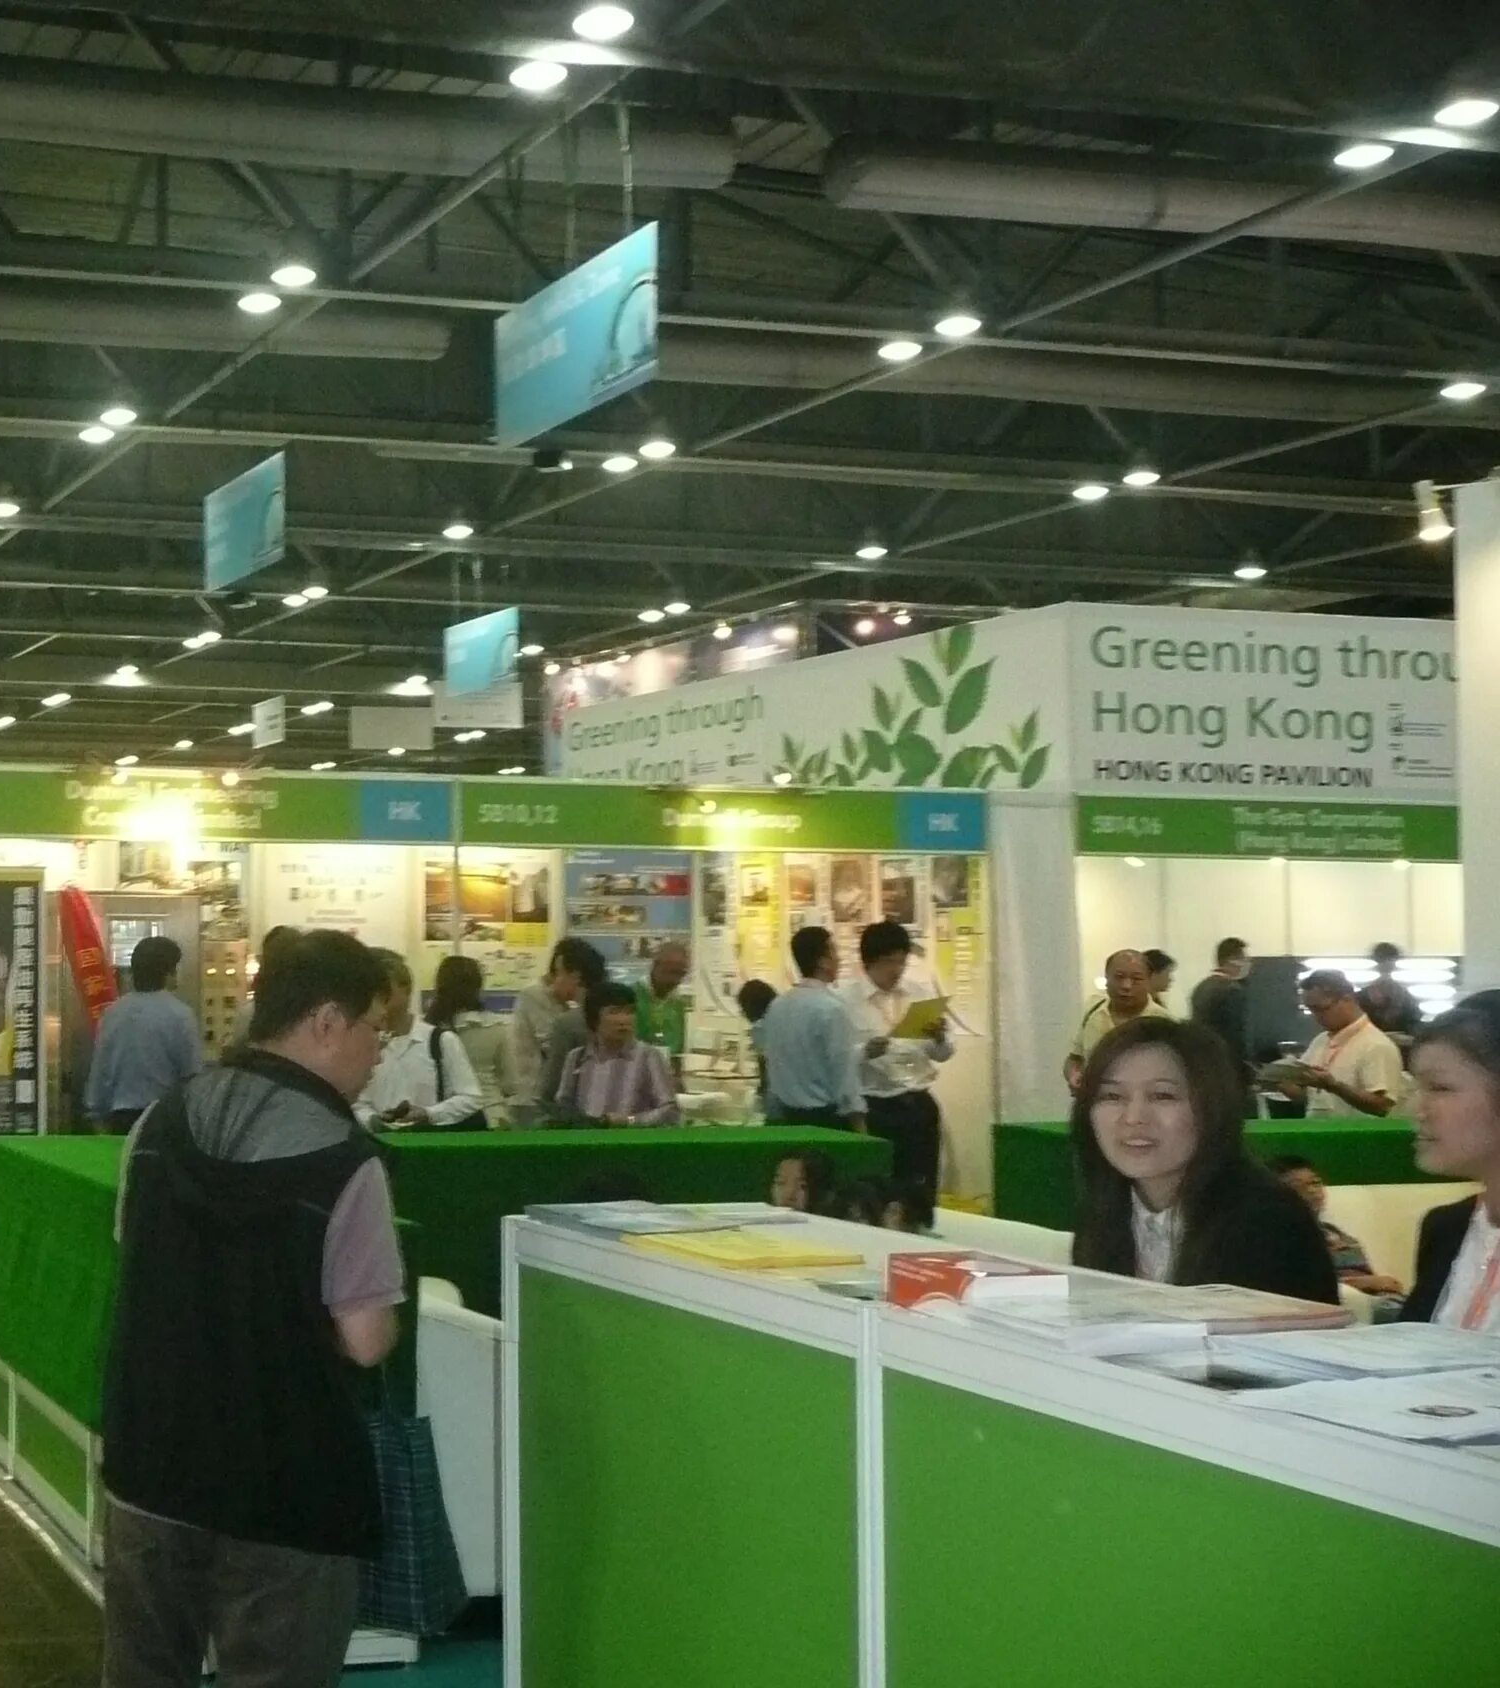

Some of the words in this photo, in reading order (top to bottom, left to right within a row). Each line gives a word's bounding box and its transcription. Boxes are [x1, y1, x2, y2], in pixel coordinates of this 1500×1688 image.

[1090, 625, 1321, 688] Greening
[568, 711, 661, 750] Greening
[666, 684, 764, 733] through
[1092, 691, 1227, 748] Hong
[1246, 697, 1374, 753] Kong
[1095, 759, 1172, 783] HONG
[1177, 761, 1253, 785] KONG
[1259, 763, 1373, 787] PAVILION
[388, 801, 421, 822] HK
[927, 811, 960, 833] HK
